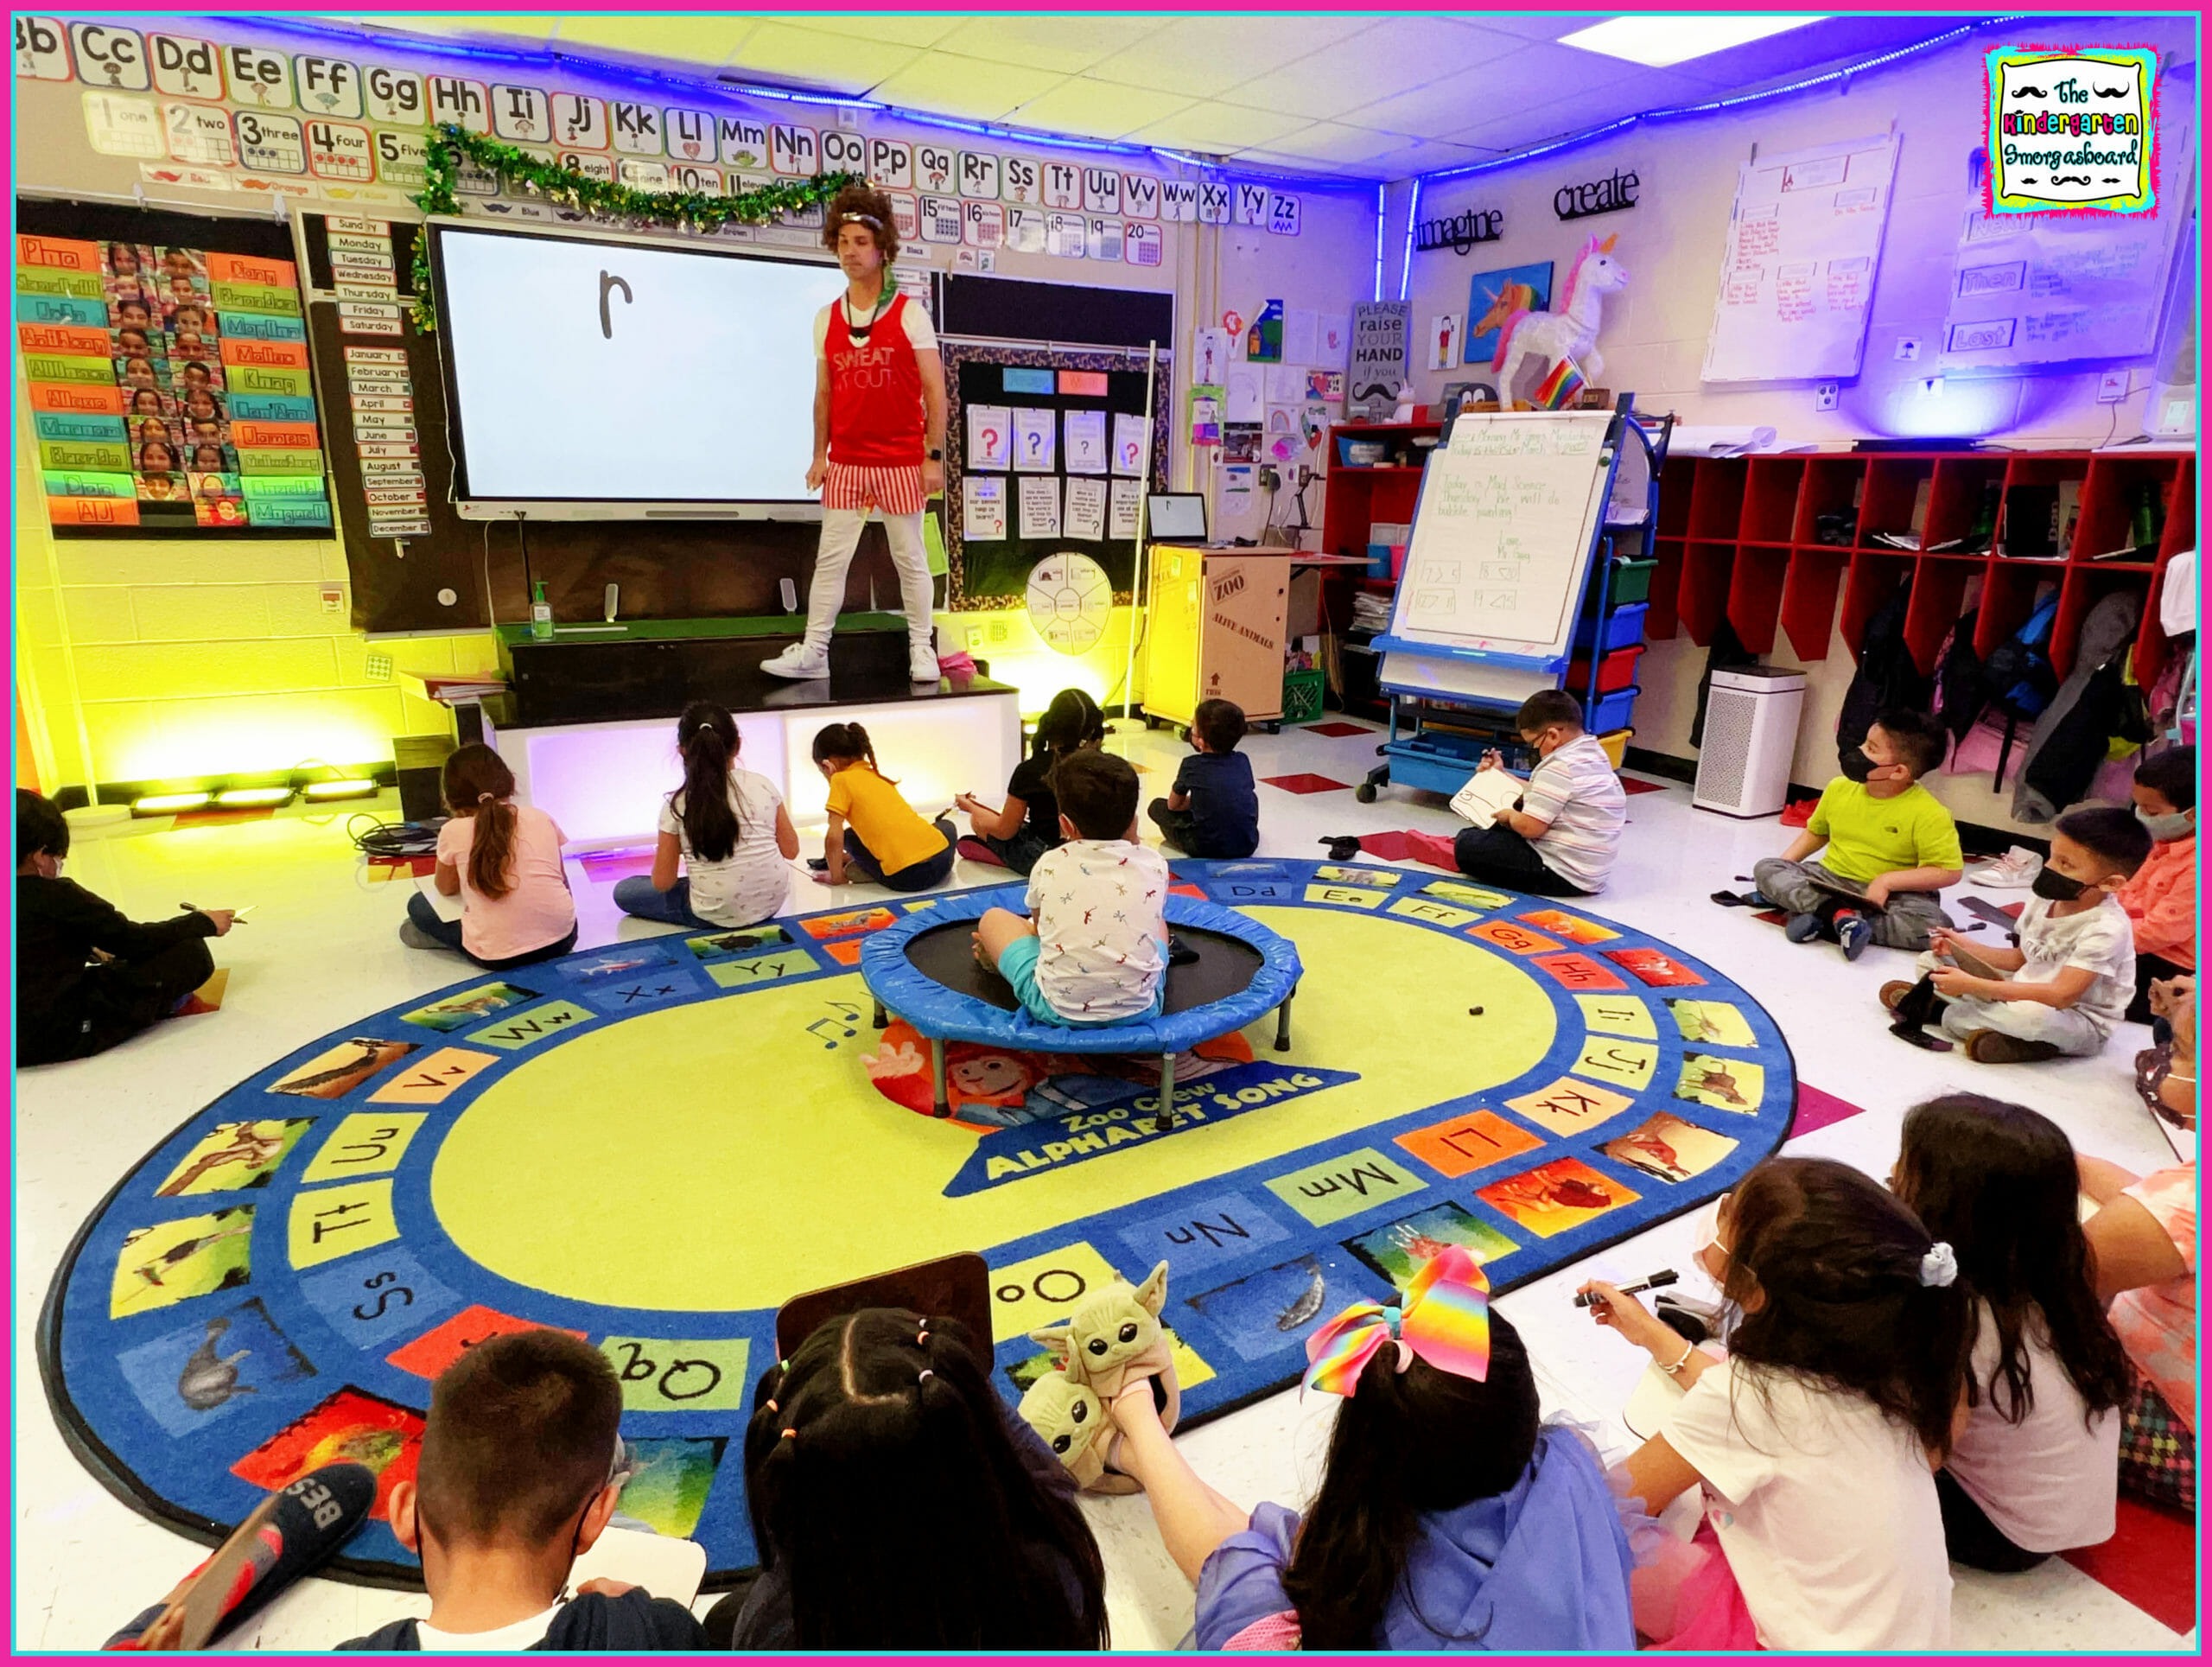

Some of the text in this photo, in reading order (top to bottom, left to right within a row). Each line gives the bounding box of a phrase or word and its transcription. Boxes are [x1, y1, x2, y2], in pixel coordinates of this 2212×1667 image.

[82, 27, 136, 63] Cc
[159, 37, 211, 75] Dd
[234, 48, 282, 84] Ee
[305, 60, 346, 93] Ff
[371, 69, 418, 110] Gg
[436, 78, 480, 113] Hh
[505, 87, 533, 118] Ii
[569, 96, 590, 132] Jj
[169, 105, 226, 133] 2 two
[241, 116, 299, 145] 3 three
[616, 102, 656, 135] Kk
[679, 112, 702, 141] Ll
[312, 124, 365, 152] 4 four
[722, 121, 765, 145] Mm
[777, 127, 813, 156] Nn
[379, 133, 399, 162] 5
[824, 134, 862, 162] Oo
[874, 142, 906, 174] Pp
[584, 163, 610, 175] eight
[921, 150, 949, 176] Qq
[964, 155, 993, 181] Rr
[1009, 161, 1033, 186] Ss
[701, 178, 719, 188] ten
[1052, 166, 1073, 192] Tt
[1090, 173, 1116, 198] Uu
[1127, 177, 1155, 202] Vv
[1163, 184, 1196, 203] Ww
[1202, 184, 1227, 208] Xx
[1241, 186, 1264, 213] Yy
[1554, 169, 1640, 220] create
[923, 199, 938, 217] 15
[967, 204, 982, 222] 16
[1009, 209, 1023, 228] 17
[1273, 196, 1295, 220] Zz
[1051, 216, 1064, 232] 18
[1090, 220, 1103, 235] 19
[1128, 224, 1144, 239] 20
[1416, 208, 1503, 255] imagine
[340, 239, 381, 251] Monday
[341, 254, 382, 267] Tuesday
[337, 270, 391, 283] Wednesday
[1965, 271, 2017, 293] Then
[343, 288, 391, 302] Thursday
[600, 269, 633, 339] r
[353, 305, 385, 317] Friday
[1358, 303, 1408, 317] PLEASE
[350, 321, 393, 332] Saturday
[1360, 317, 1402, 331] raise
[1357, 332, 1402, 346] YOUR
[1956, 325, 2006, 348] Last
[349, 350, 391, 362] January
[834, 347, 894, 371] SWEAT
[1357, 348, 1403, 362] HAND
[245, 368, 296, 396] King
[351, 366, 399, 379] February
[1376, 368, 1395, 380] you
[358, 384, 392, 393] March
[360, 399, 385, 410] April
[362, 415, 385, 426] May
[243, 426, 310, 446] James
[364, 431, 387, 440] June
[367, 446, 387, 456] July
[367, 462, 401, 473] August
[367, 477, 415, 487] September
[369, 493, 411, 501] October
[79, 501, 112, 522] AJ
[372, 507, 417, 516] November
[373, 524, 417, 533] December
[1214, 575, 1244, 601] ZOO
[1239, 626, 1274, 650] ANIMALS
[1231, 885, 1276, 898] Dd
[1324, 890, 1363, 903] Ee
[1411, 905, 1458, 920] Ff
[1491, 928, 1532, 950] Gg
[735, 962, 786, 977] Yy
[1550, 961, 1595, 984] Hh
[616, 984, 676, 1003] Xx
[489, 1011, 573, 1042] Ww
[1586, 1048, 1647, 1078] Jj
[403, 1065, 466, 1089] Vv
[1212, 1072, 1324, 1111] SONG
[1535, 1089, 1601, 1117] Kk
[1059, 1082, 1216, 1133] Zoo Cew
[331, 1127, 399, 1165] Uu
[1298, 1161, 1400, 1199] Mm
[313, 1202, 371, 1244] Tt
[1165, 1212, 1251, 1248] Nn
[353, 1271, 414, 1321] Ss
[996, 1269, 1086, 1303] Oo
